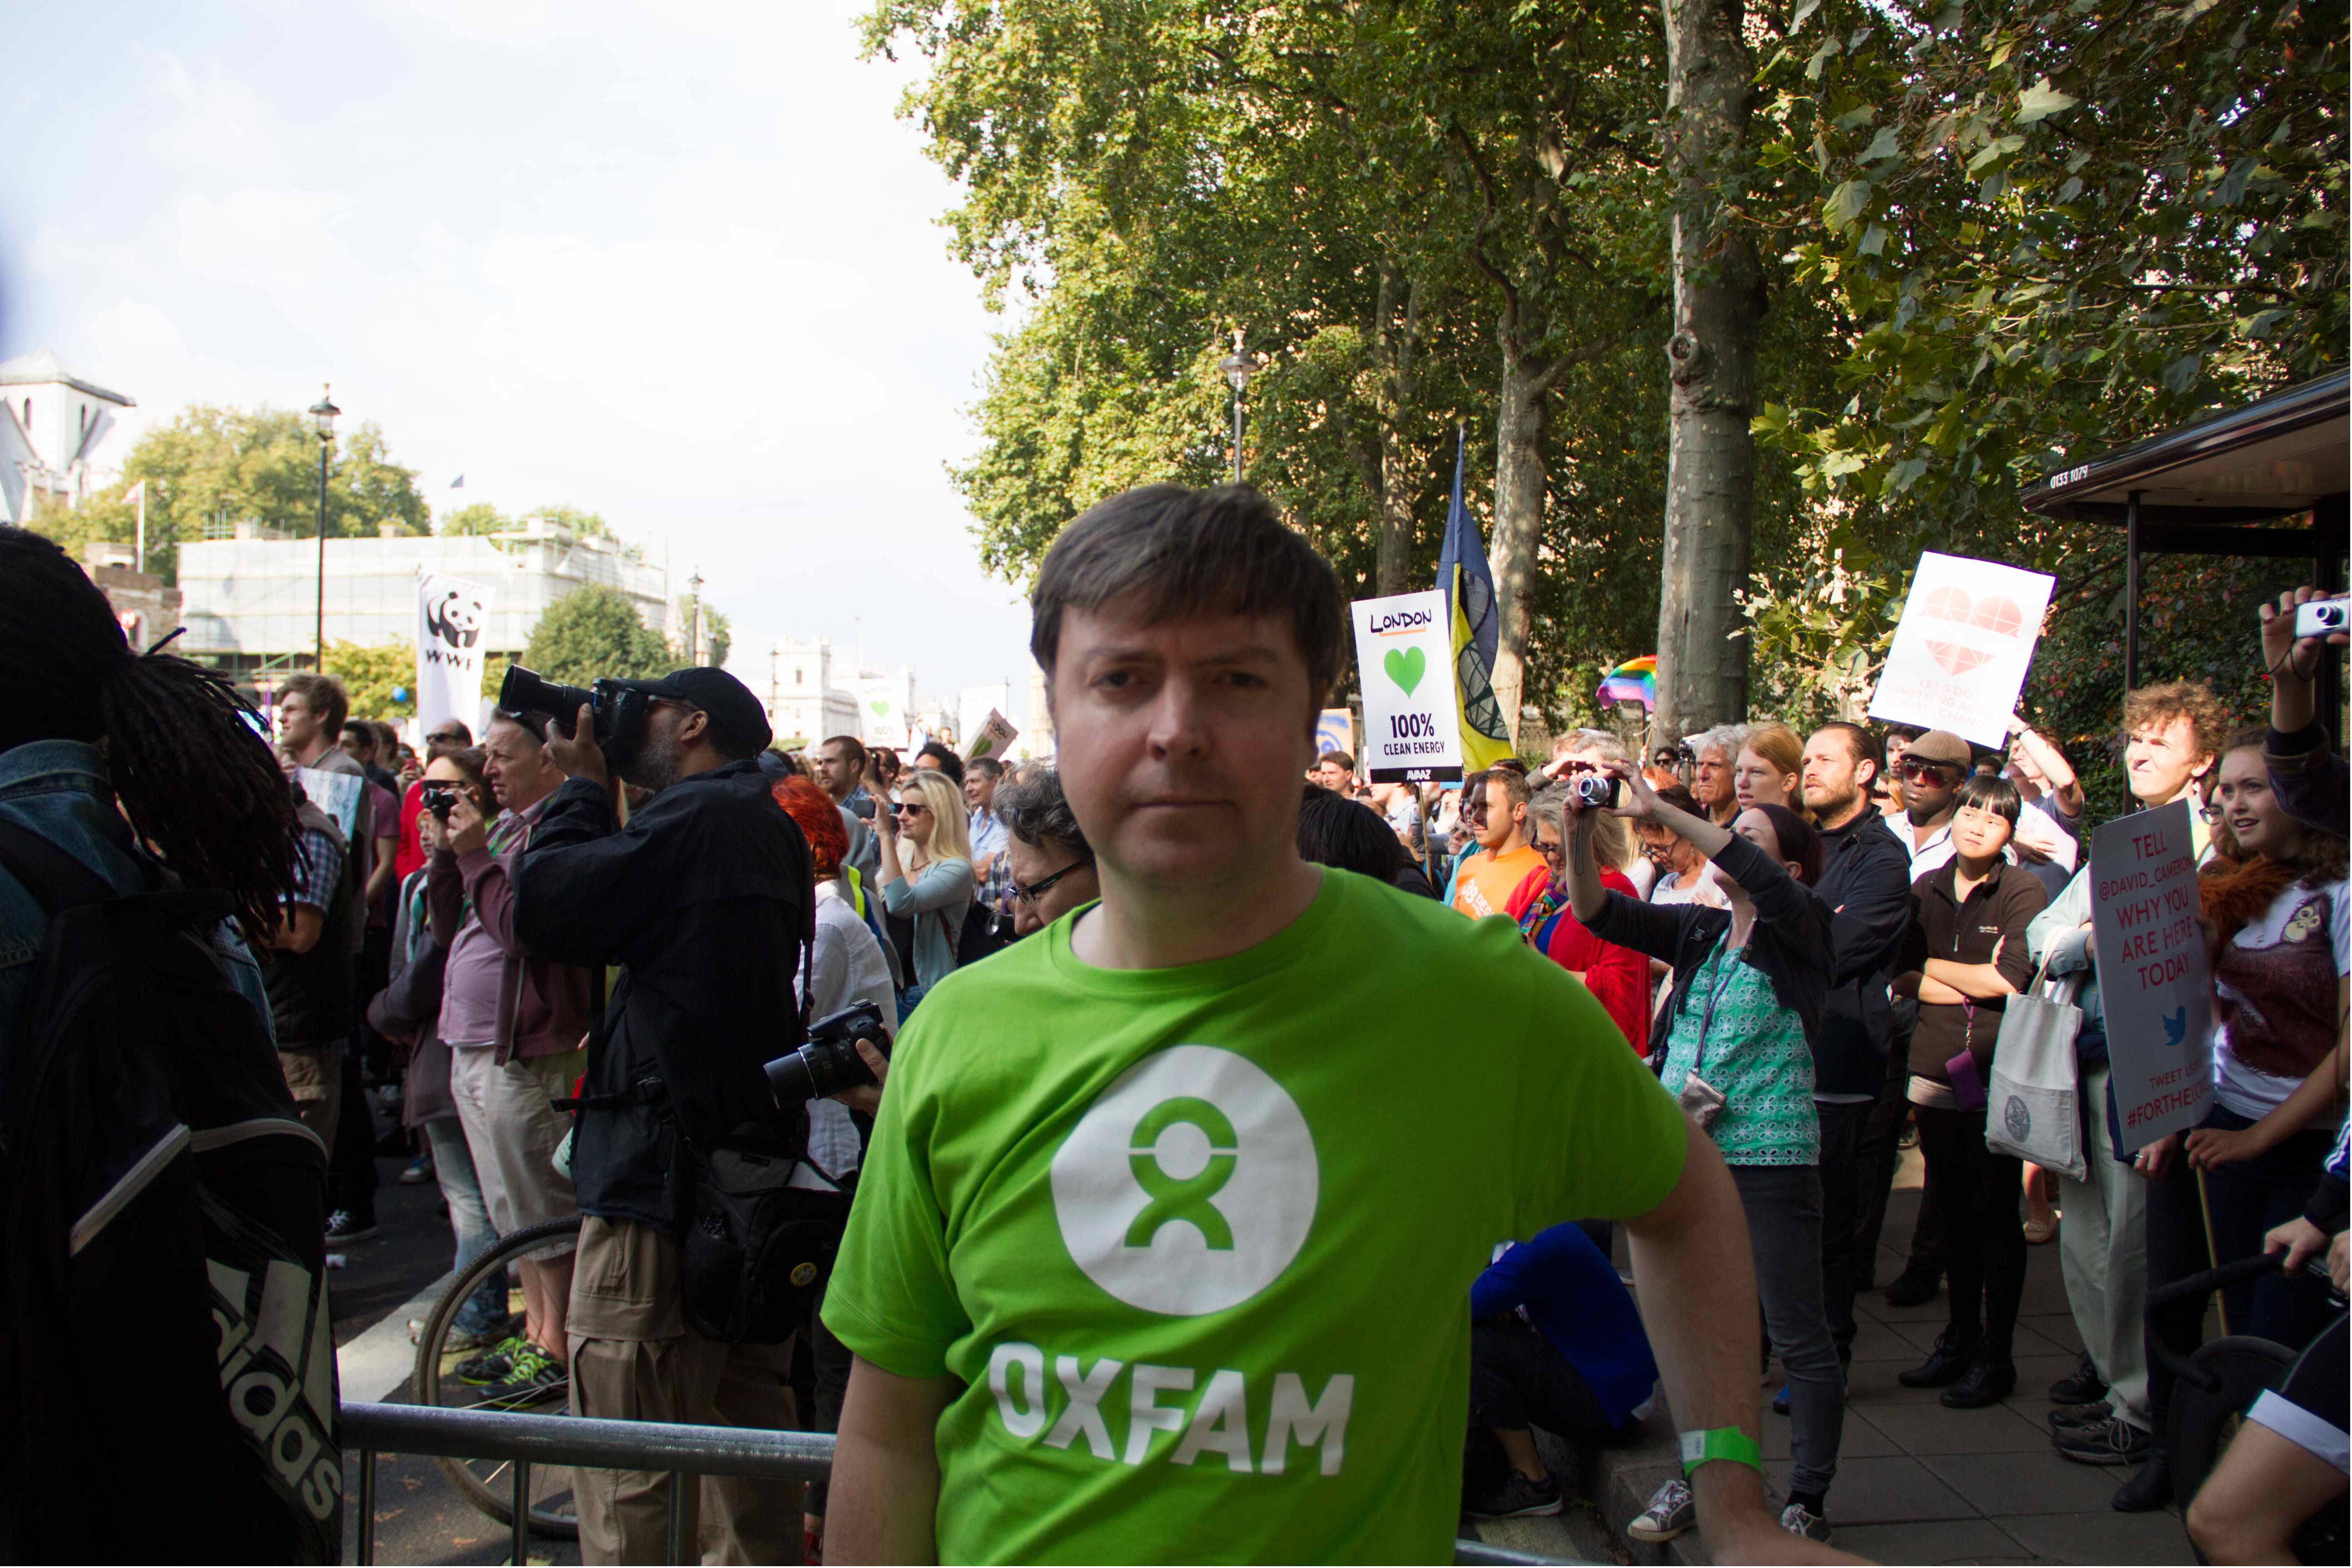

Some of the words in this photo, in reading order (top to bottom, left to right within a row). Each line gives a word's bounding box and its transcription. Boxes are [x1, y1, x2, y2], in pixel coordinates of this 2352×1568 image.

[2050, 471, 2069, 489] 0133
[2070, 465, 2089, 482] 1079
[1371, 608, 1431, 633] LONDON
[1920, 679, 1950, 693] LETS
[1886, 697, 1931, 713] CLIMAT
[1391, 713, 1434, 738] 100%
[1384, 743, 1411, 755] CLEAN
[1413, 741, 1445, 755] ENERGY
[2132, 830, 2167, 860] TELL
[2099, 853, 2193, 901] @DAVID_CAMERON
[2116, 896, 2161, 930] WHY
[2163, 885, 2189, 915] YOU
[2122, 931, 2159, 963] ARE
[2163, 915, 2192, 950] HERE
[2137, 951, 2189, 990] TODAY
[2149, 1068, 2182, 1090] TWEET
[989, 1342, 1354, 1475] OXFAM
